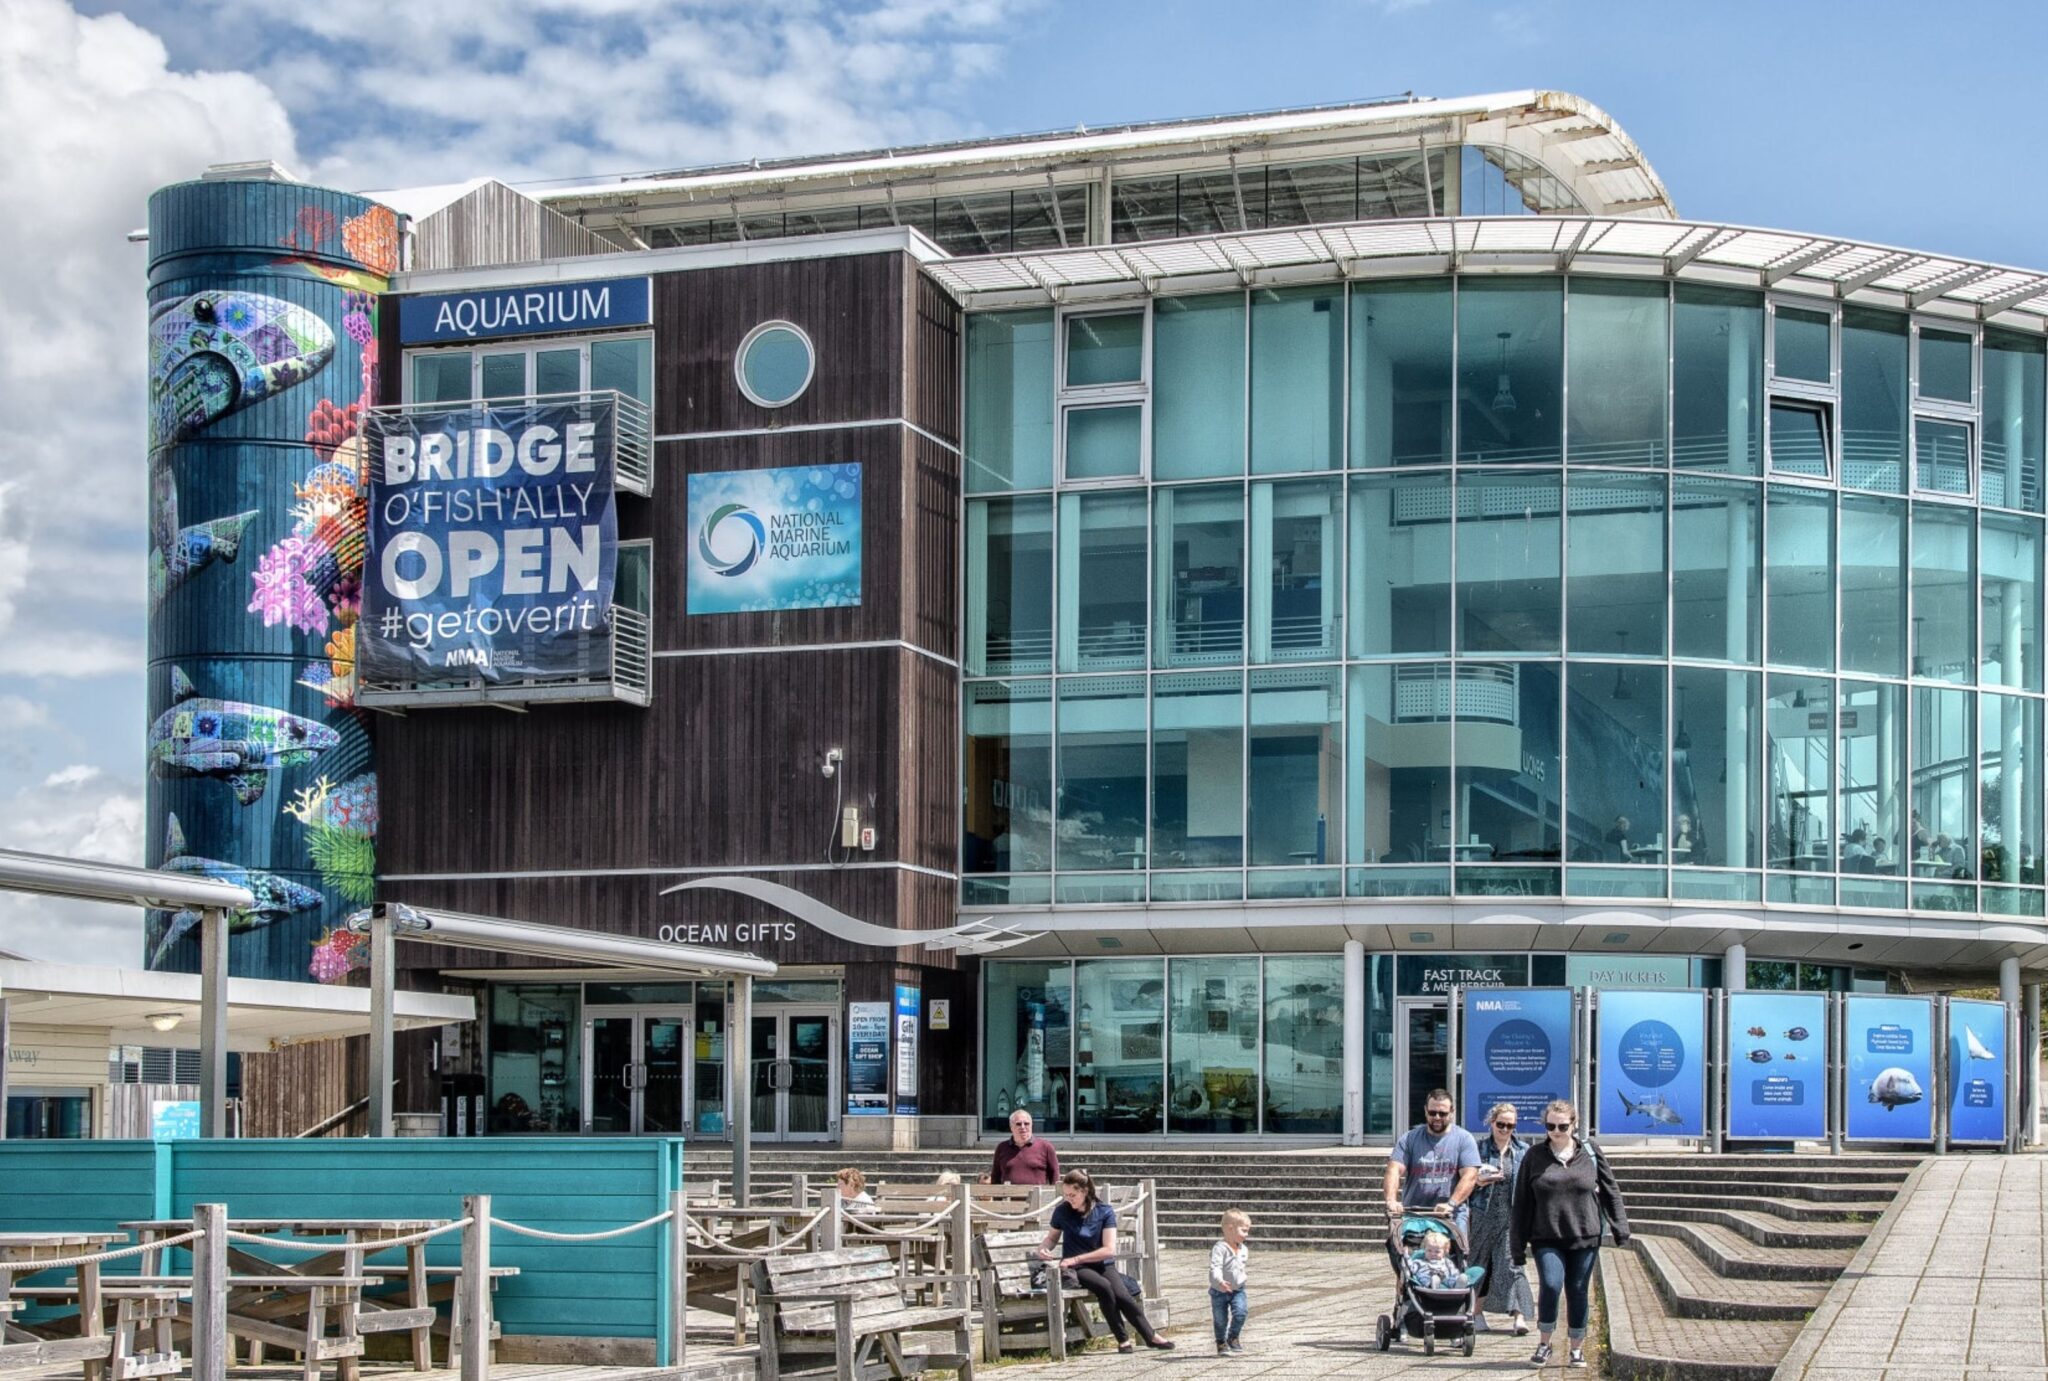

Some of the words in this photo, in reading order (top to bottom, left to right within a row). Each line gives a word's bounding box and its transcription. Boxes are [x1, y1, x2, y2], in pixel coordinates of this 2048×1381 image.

[435, 287, 610, 336] AQUARIUM
[384, 422, 596, 486] BRIDGE
[384, 482, 595, 526] O'FISH'ALLY
[770, 512, 844, 529] NATIONAL
[770, 526, 831, 544] MARINE
[769, 540, 851, 561] AQUARIUM
[381, 525, 601, 600] OPEN
[380, 597, 595, 649] #getoverit
[444, 648, 489, 667] NMA
[658, 924, 728, 943] OCEAN
[735, 923, 796, 942] GIFTS
[1423, 969, 1455, 981] FAST
[1458, 969, 1502, 981] TRACK
[1590, 970, 1615, 982] DAY
[1619, 971, 1668, 983] TICKETS
[1422, 982, 1430, 992] &
[1476, 1000, 1502, 1011] NMA
